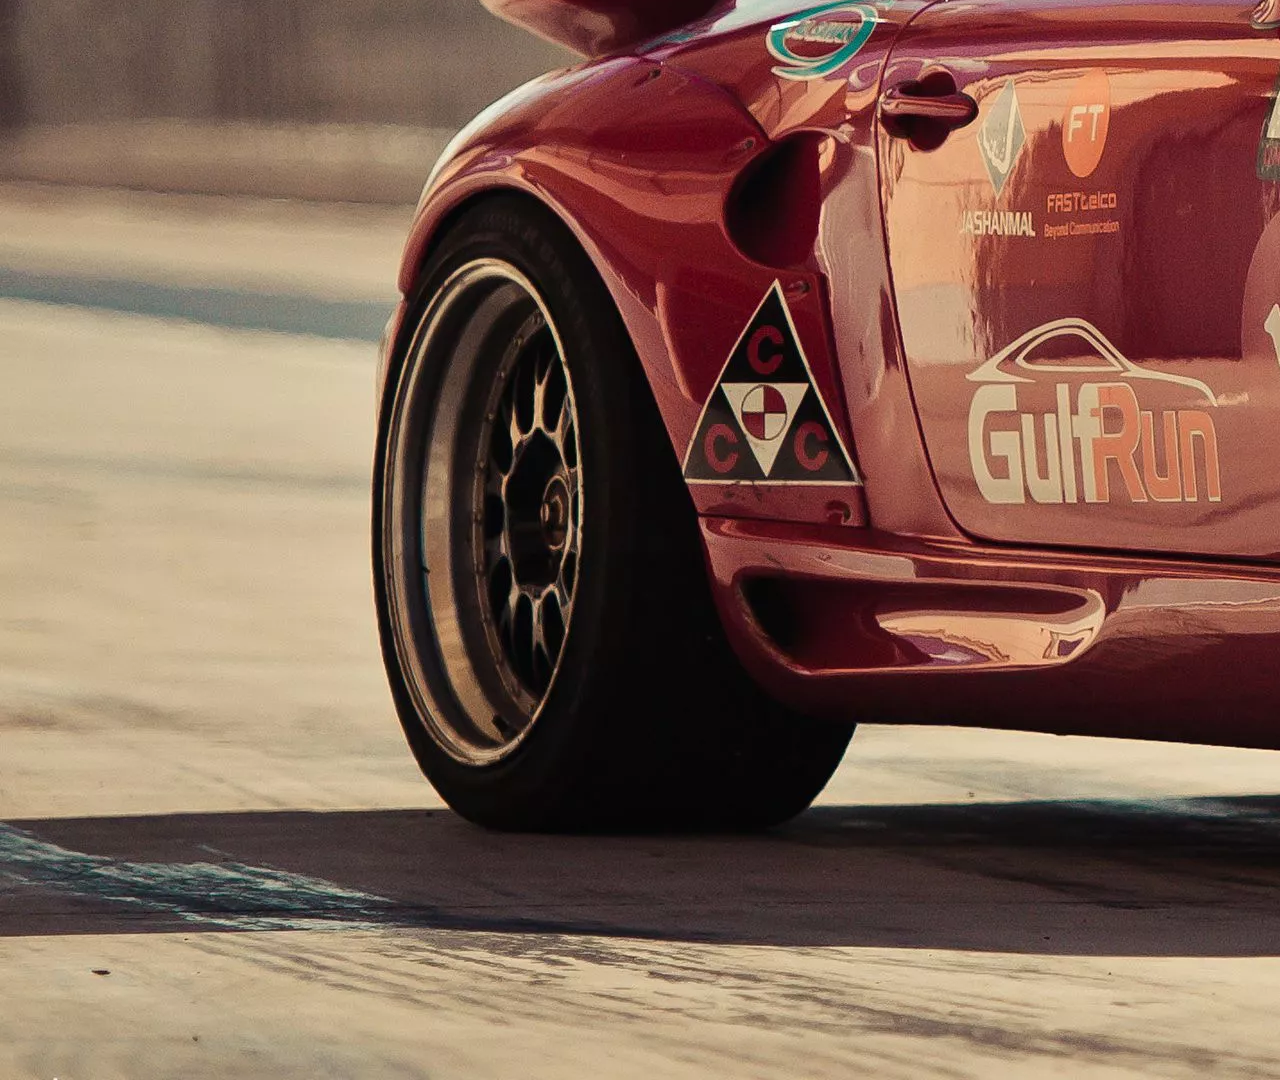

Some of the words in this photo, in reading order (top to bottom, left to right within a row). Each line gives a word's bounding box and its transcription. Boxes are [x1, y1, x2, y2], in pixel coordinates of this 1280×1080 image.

[1067, 104, 1105, 144] FT
[960, 209, 1036, 238] JASHANMAL
[747, 325, 784, 375] C
[704, 423, 739, 473] C
[794, 422, 829, 471] C
[967, 382, 1222, 504] GulfRun
